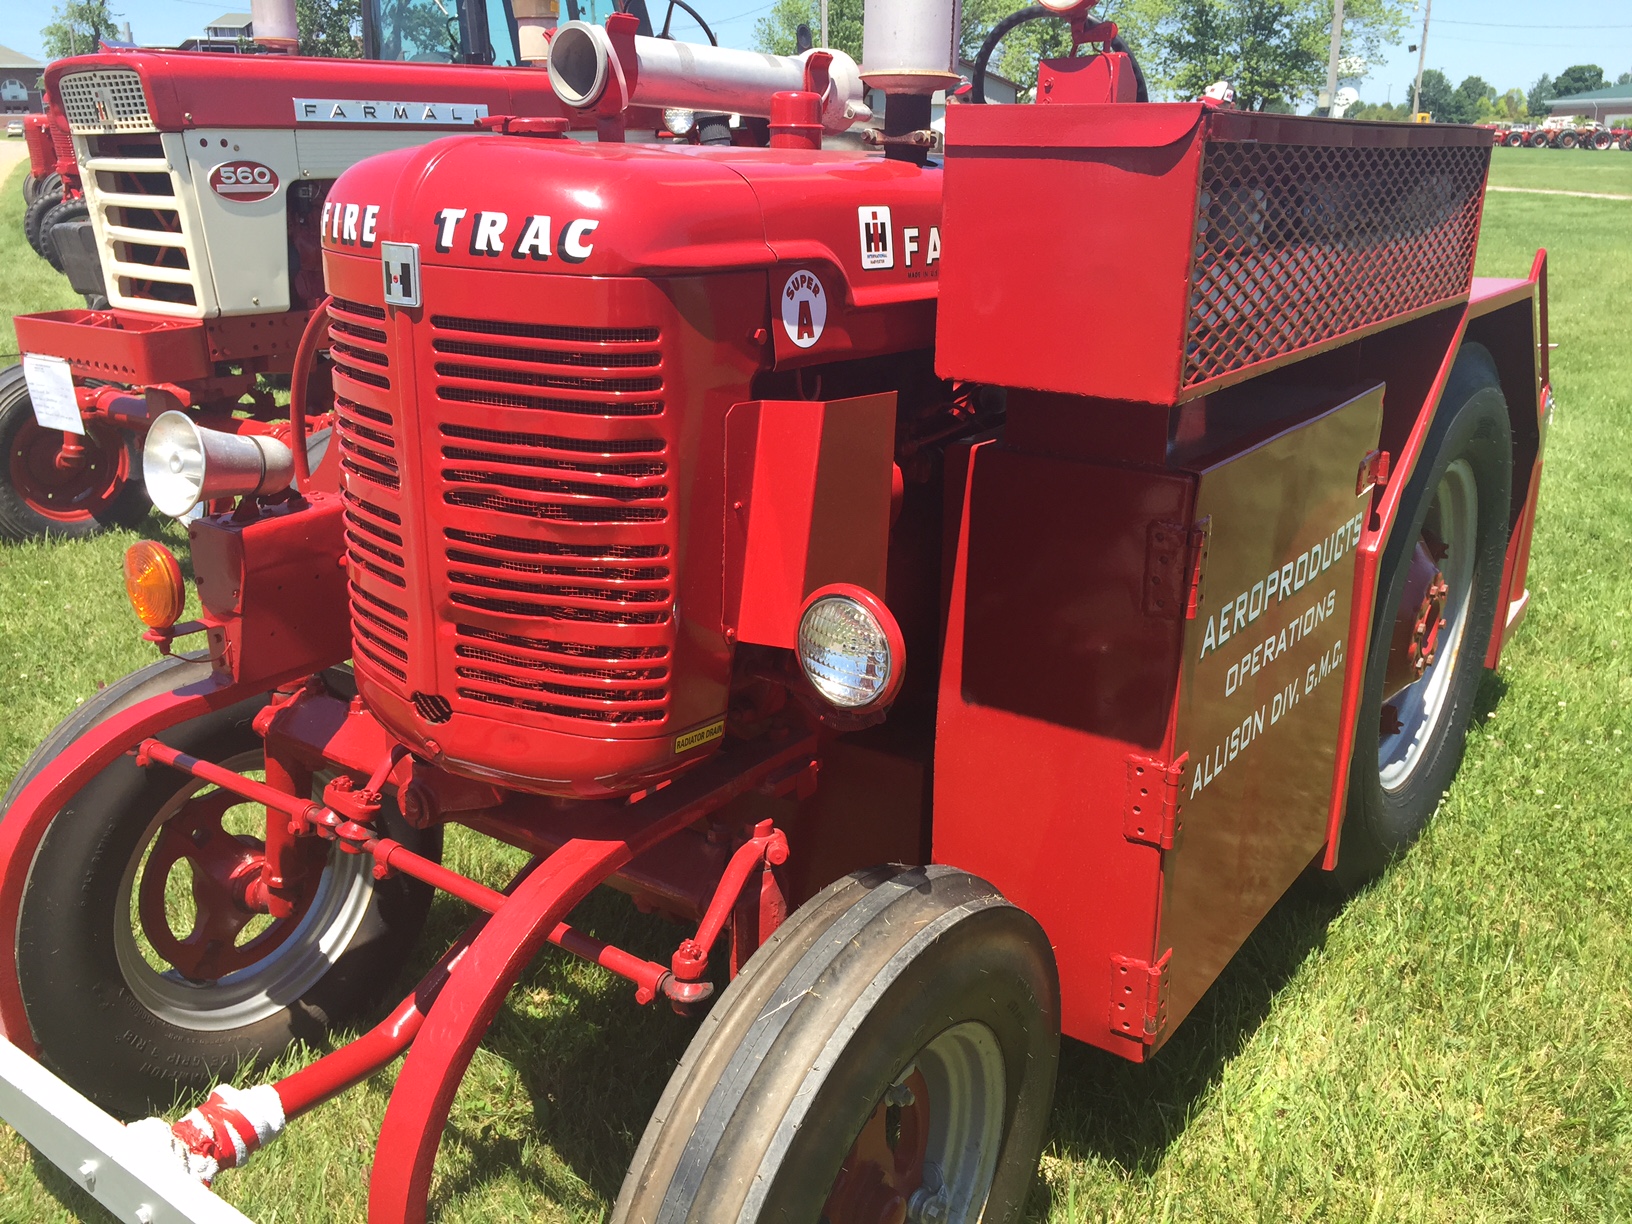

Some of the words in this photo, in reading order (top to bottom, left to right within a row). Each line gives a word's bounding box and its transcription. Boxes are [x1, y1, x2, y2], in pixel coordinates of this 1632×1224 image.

[220, 166, 271, 184] 560
[321, 202, 380, 246] FIRE
[435, 208, 599, 262] TRAC
[786, 274, 820, 301] SUPER
[797, 300, 815, 340] A
[1200, 512, 1363, 660] AEROPRODUCTS
[1225, 589, 1336, 697] OPERATIONS
[676, 731, 705, 750] RADIATOR
[705, 724, 723, 739] DRAIN
[1190, 705, 1266, 800] ALLISON
[1270, 677, 1300, 726] DIV.
[1304, 640, 1343, 695] G.M.C.
